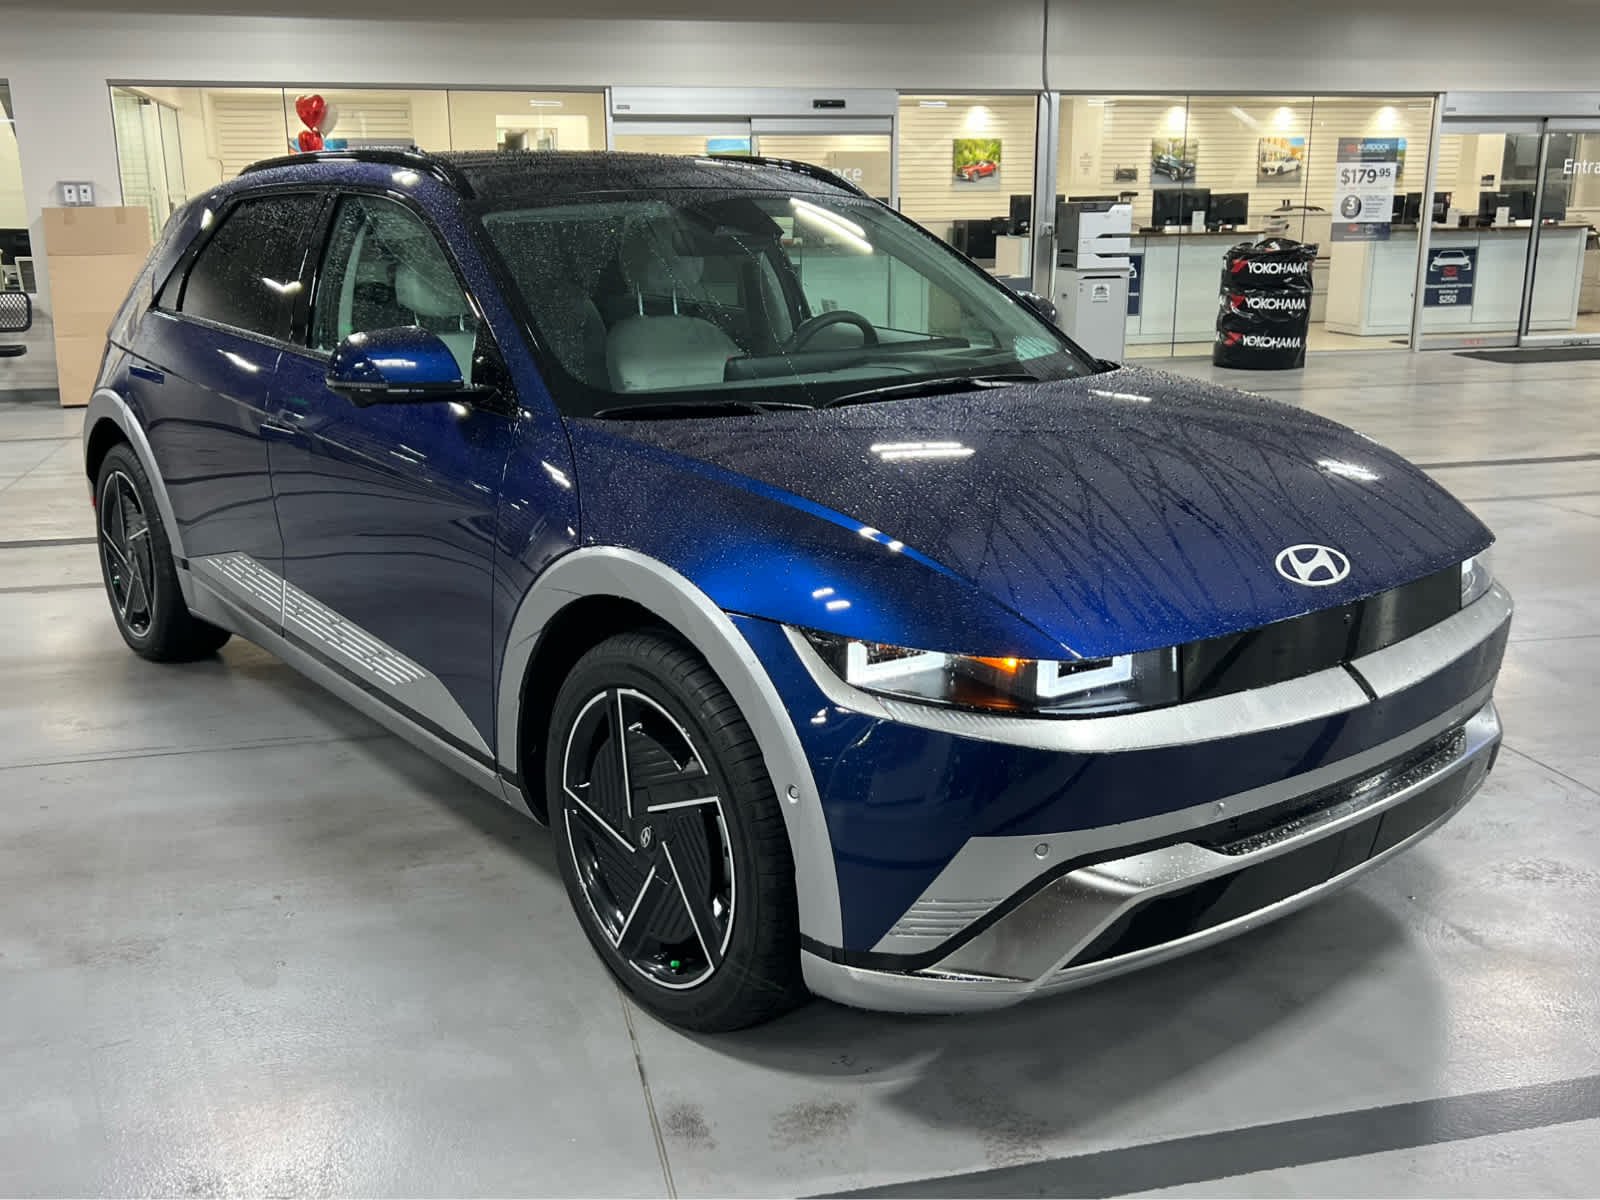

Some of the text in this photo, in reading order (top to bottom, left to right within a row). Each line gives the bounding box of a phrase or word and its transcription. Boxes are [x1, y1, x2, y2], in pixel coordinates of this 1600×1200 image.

[1346, 197, 1355, 210] 3
[1248, 262, 1308, 274] YOKOHAMA
[1246, 298, 1306, 309] YOKOHAMA
[1243, 336, 1300, 348] YOKOHAMA
